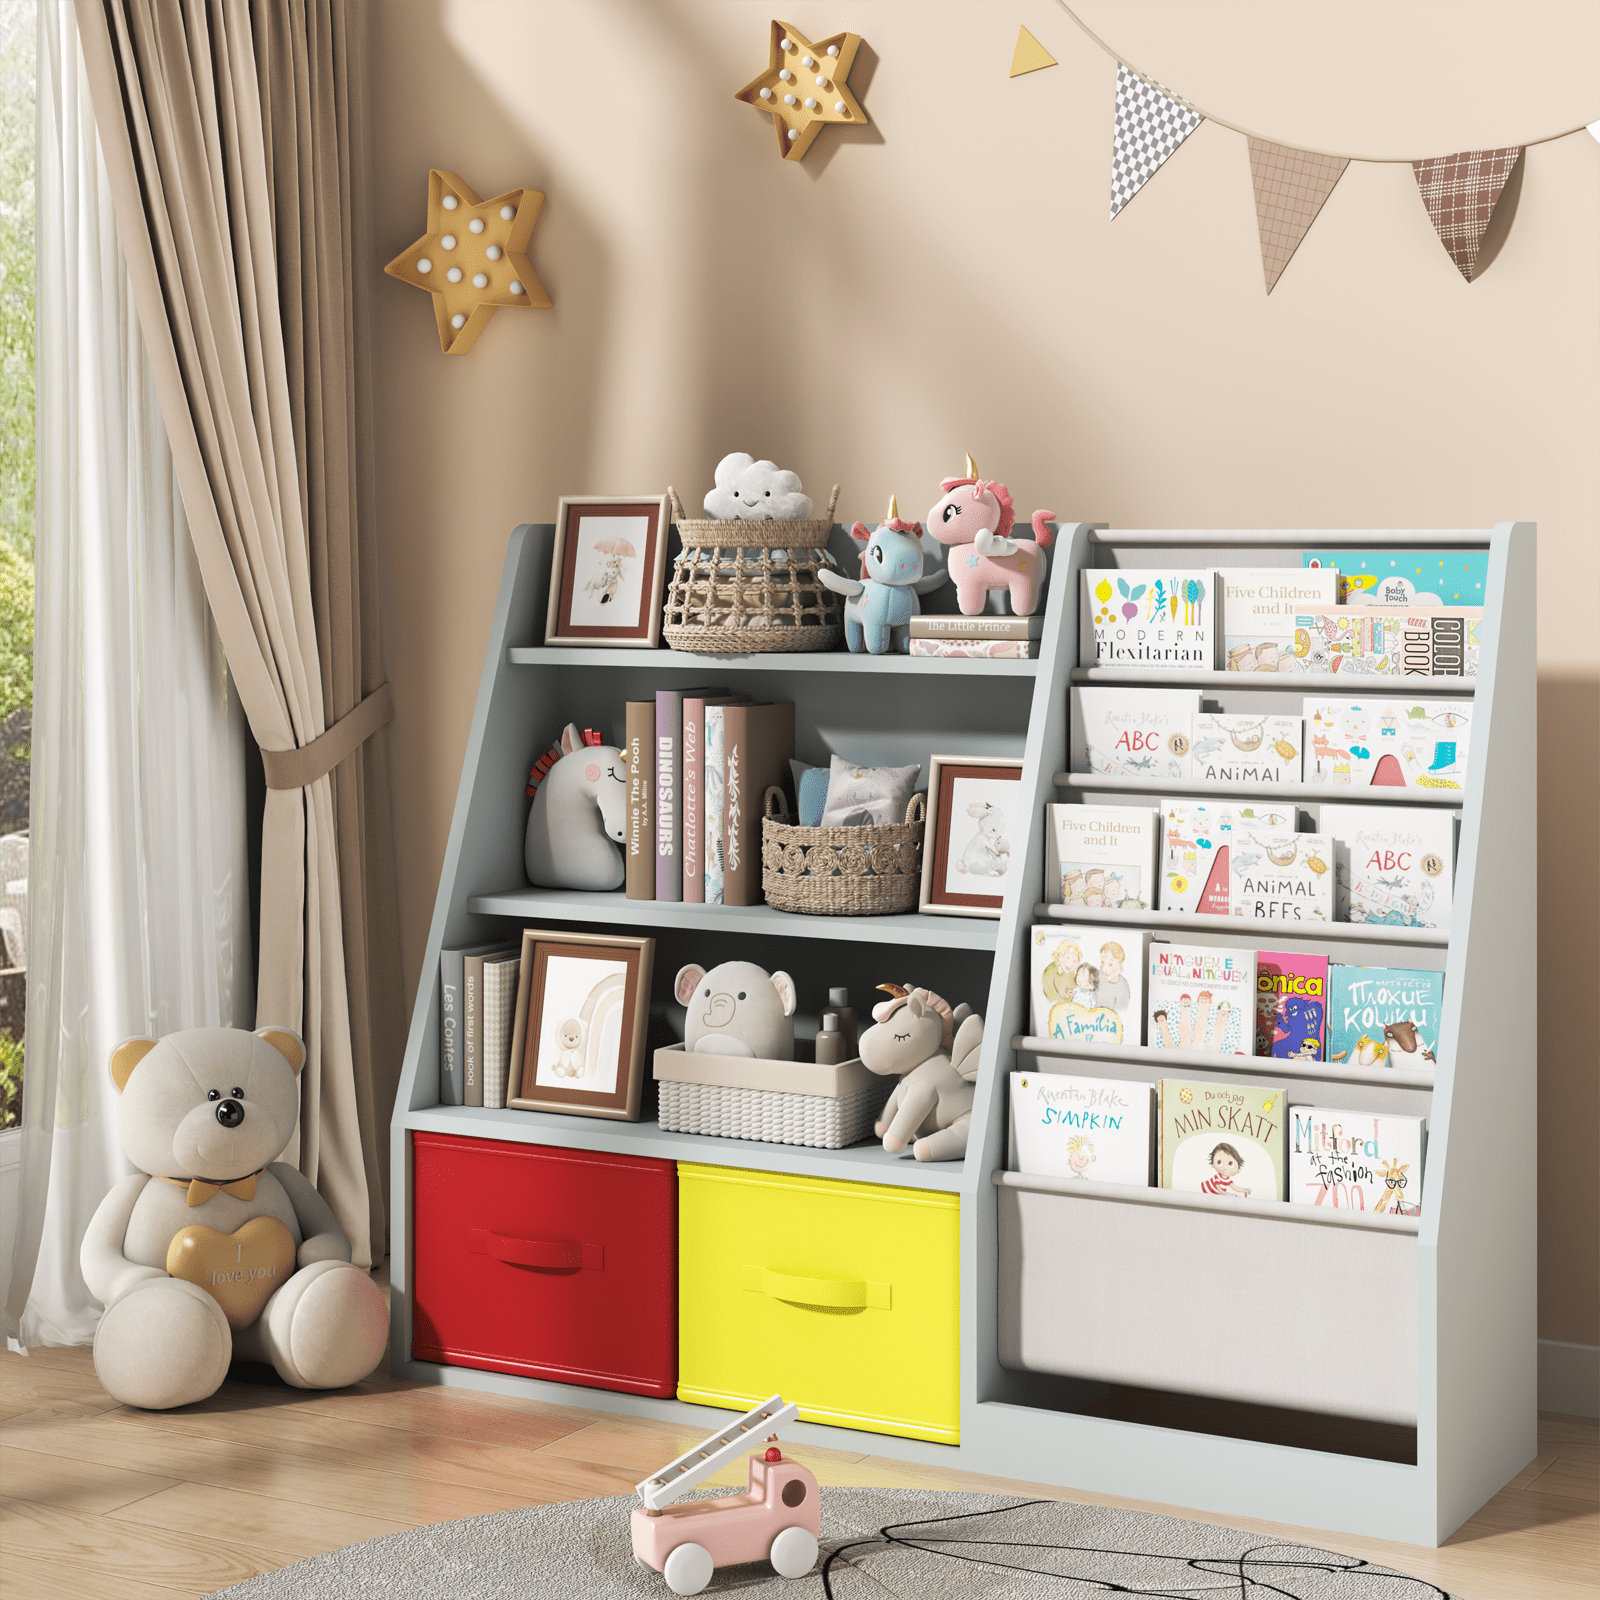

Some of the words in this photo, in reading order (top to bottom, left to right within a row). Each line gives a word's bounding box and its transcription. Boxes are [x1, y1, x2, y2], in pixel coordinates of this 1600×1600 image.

[1225, 585, 1255, 599] Five
[1258, 585, 1322, 599] Children
[1384, 593, 1408, 602] Touch
[1385, 586, 1406, 596] Baby
[1252, 602, 1280, 615] and
[1284, 602, 1294, 615] It
[926, 620, 945, 631] The
[948, 620, 975, 632] Little
[978, 621, 1011, 632] Prince
[1094, 629, 1204, 642] MODERN
[1095, 642, 1203, 661] Flexitarian
[1403, 630, 1430, 676] BOOK
[685, 721, 697, 763] Web
[1115, 730, 1160, 752] ABC
[631, 737, 640, 774] Pooh
[631, 777, 640, 803] The
[658, 736, 674, 857] DINOSAURS
[631, 808, 640, 856] Winnie
[642, 816, 649, 827] by
[1062, 819, 1087, 831] Five
[1089, 821, 1141, 834] Children
[1083, 835, 1106, 846] and
[1110, 835, 1118, 846] It
[1365, 850, 1412, 871] ABC
[444, 984, 457, 1012] Les
[467, 976, 475, 1012] words
[467, 1015, 475, 1038] first
[1053, 1023, 1065, 1040] A
[444, 1016, 457, 1072] Contes
[467, 1041, 475, 1053] of
[467, 1057, 475, 1086] book
[1204, 1091, 1216, 1101] Du
[1216, 1090, 1230, 1100] och
[1228, 1091, 1245, 1106] jag
[1041, 1107, 1123, 1130] SIMPKIN
[1174, 1106, 1212, 1139] MIN
[1217, 1105, 1278, 1143] SKATT
[1294, 1113, 1381, 1160] Mitford
[1310, 1153, 1322, 1166] at
[1328, 1151, 1348, 1165] the
[1315, 1161, 1373, 1191] fashion
[236, 1243, 241, 1262] I
[211, 1268, 242, 1285] love
[245, 1265, 278, 1285] you
